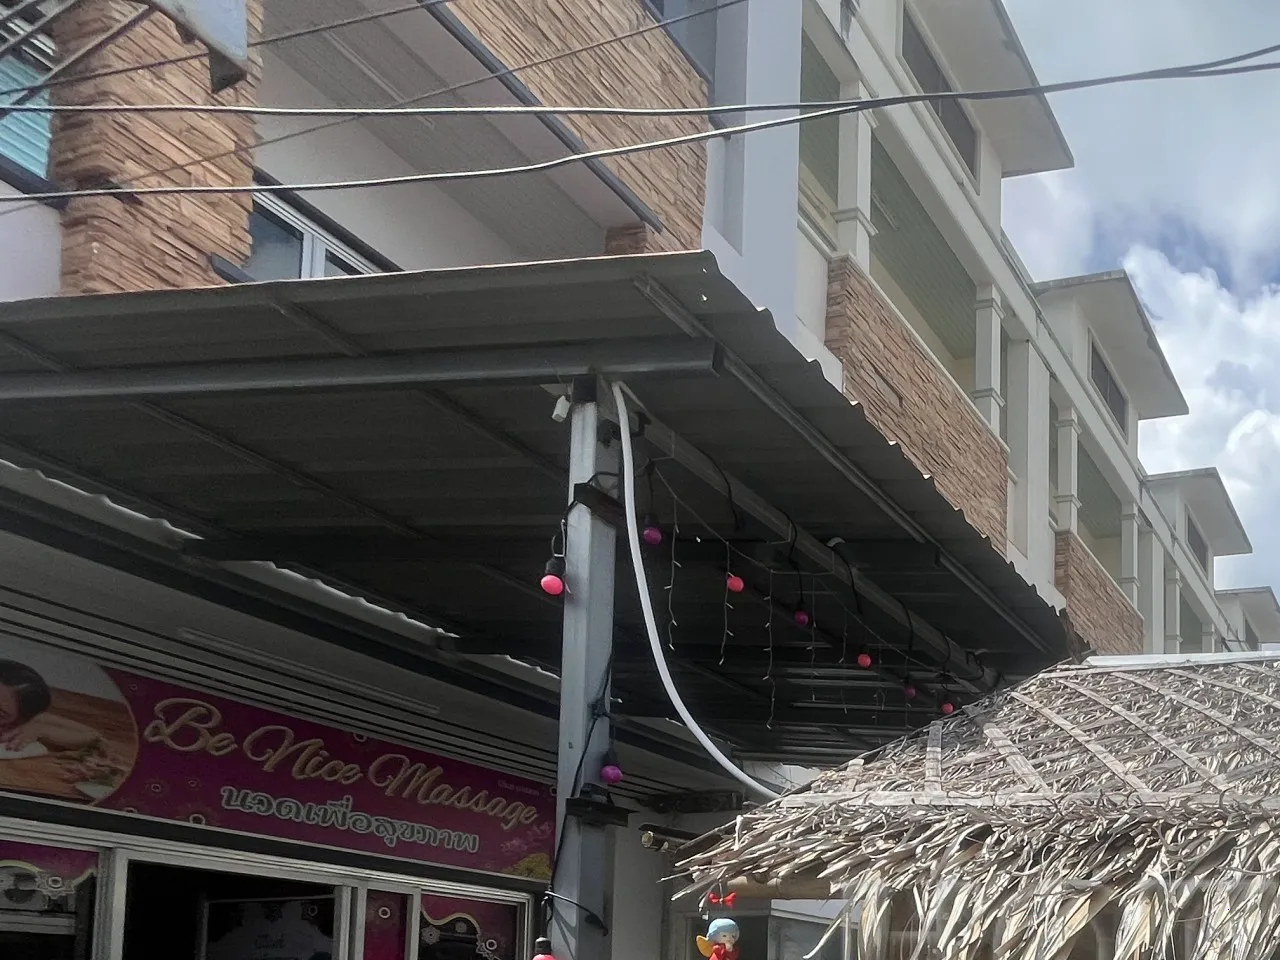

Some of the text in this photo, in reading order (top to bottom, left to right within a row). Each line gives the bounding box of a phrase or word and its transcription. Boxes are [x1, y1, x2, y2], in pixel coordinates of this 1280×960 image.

[143, 696, 539, 831] Be Nice Massage
[219, 785, 481, 855] นวดเพื่อสุขภาพ
